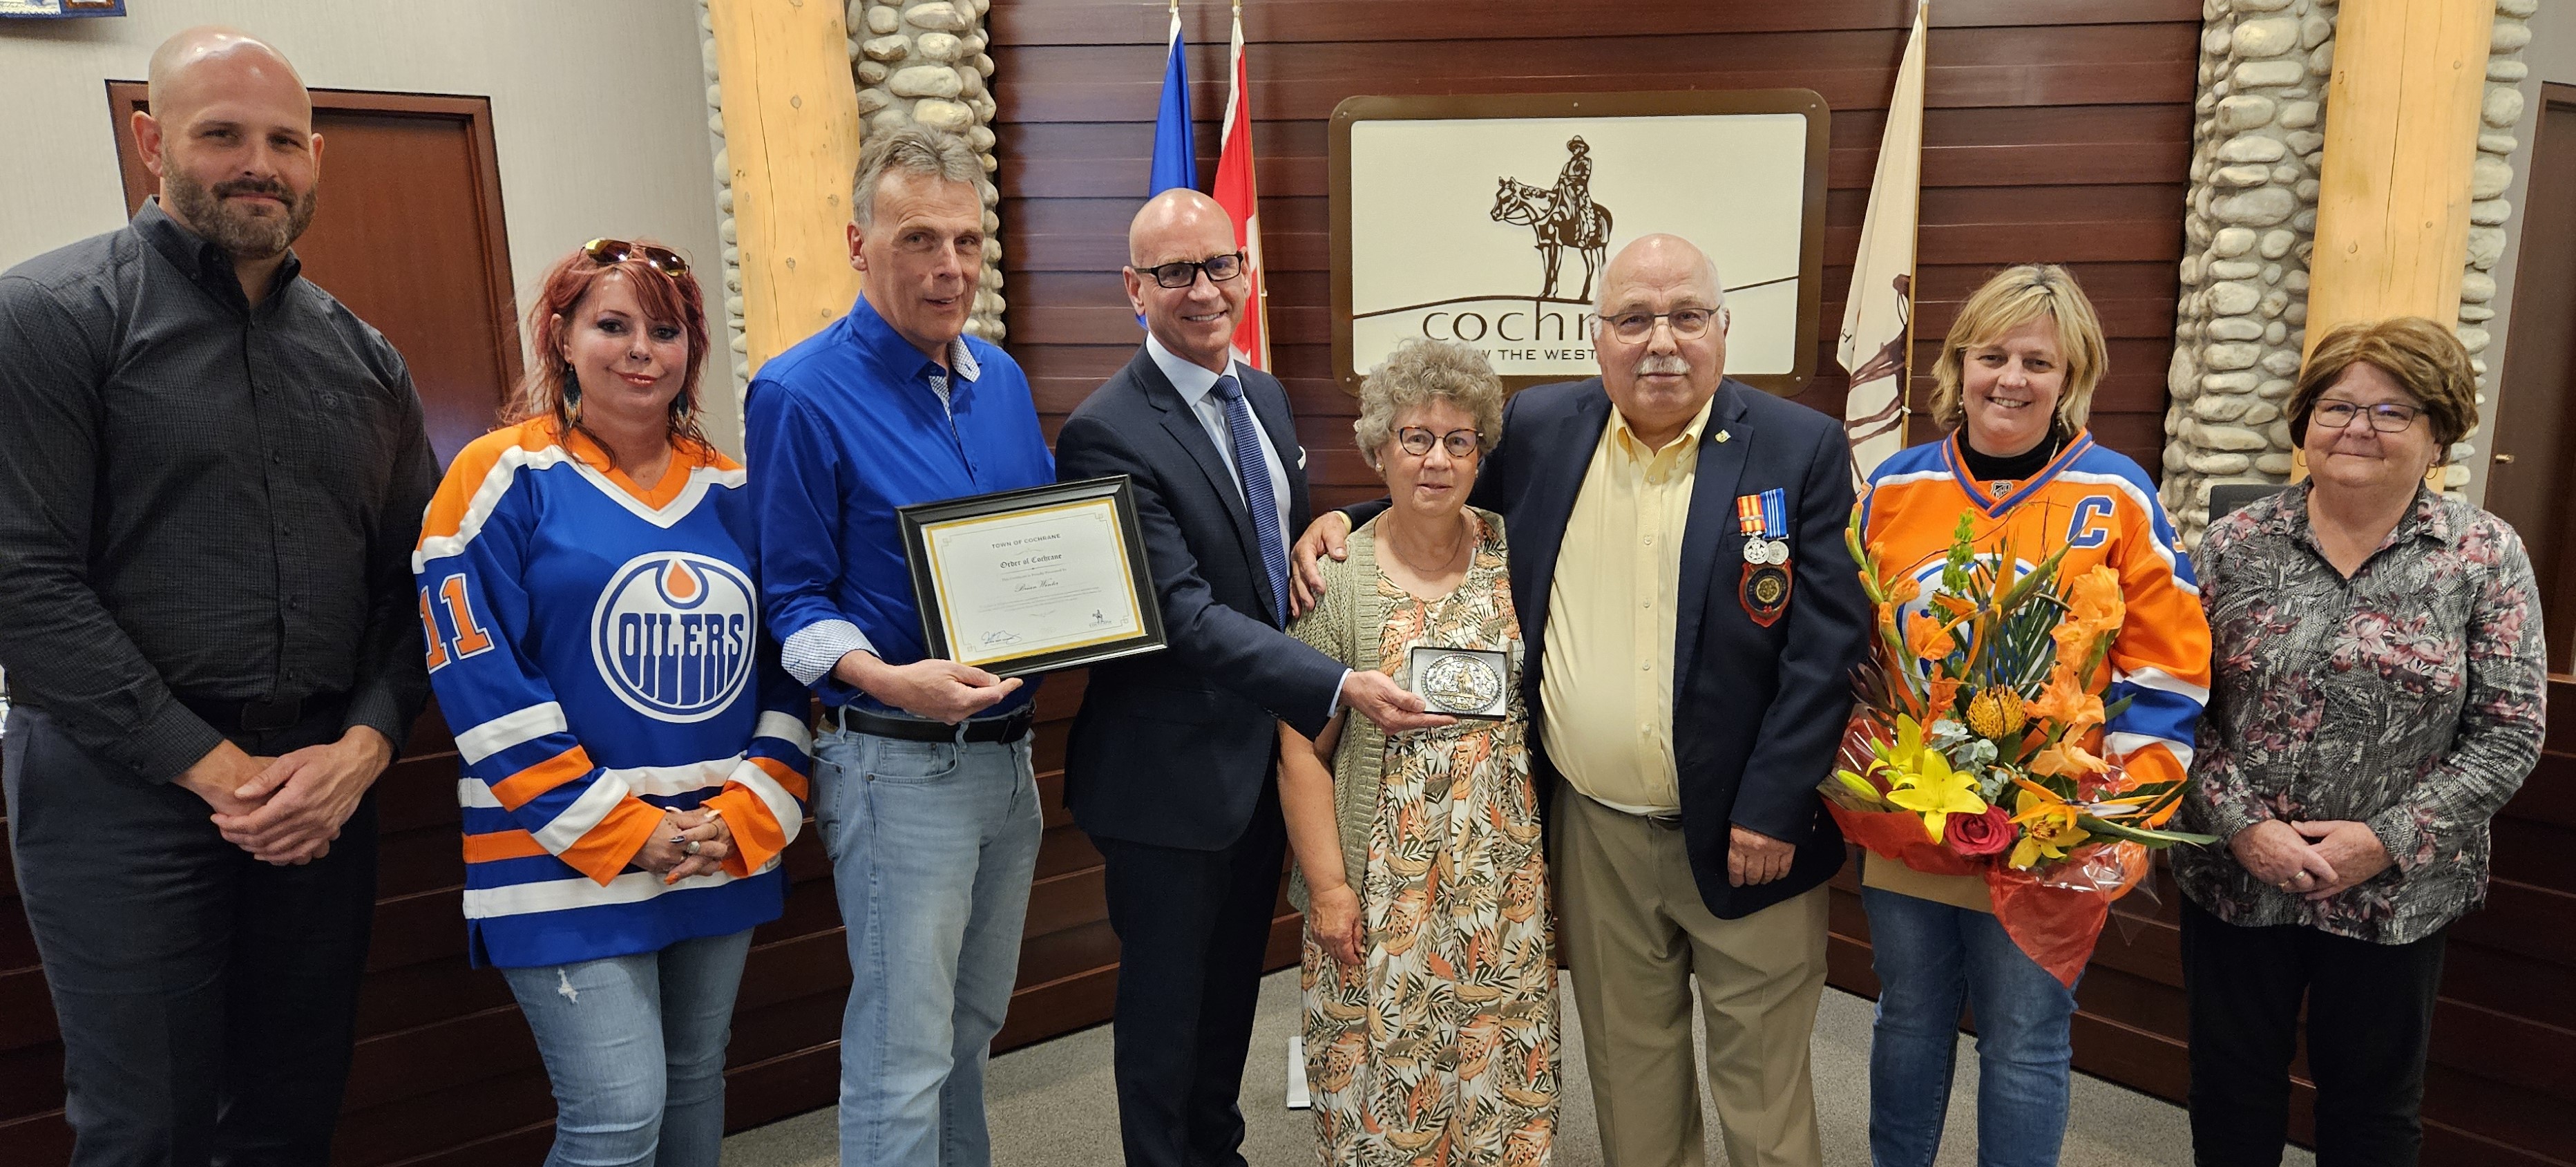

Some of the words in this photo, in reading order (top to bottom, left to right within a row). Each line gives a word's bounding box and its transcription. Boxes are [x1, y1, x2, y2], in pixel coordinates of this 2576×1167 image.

[1422, 300, 1592, 341] cochr
[1498, 349, 1536, 360] THE
[1545, 349, 1596, 360] WEST
[1024, 533, 1061, 544] COCHRANE
[2065, 495, 2116, 549] C
[1000, 560, 1021, 569] Order
[1031, 554, 1062, 564] Cochrane
[419, 573, 495, 674] 11
[618, 612, 744, 706] OILERS
